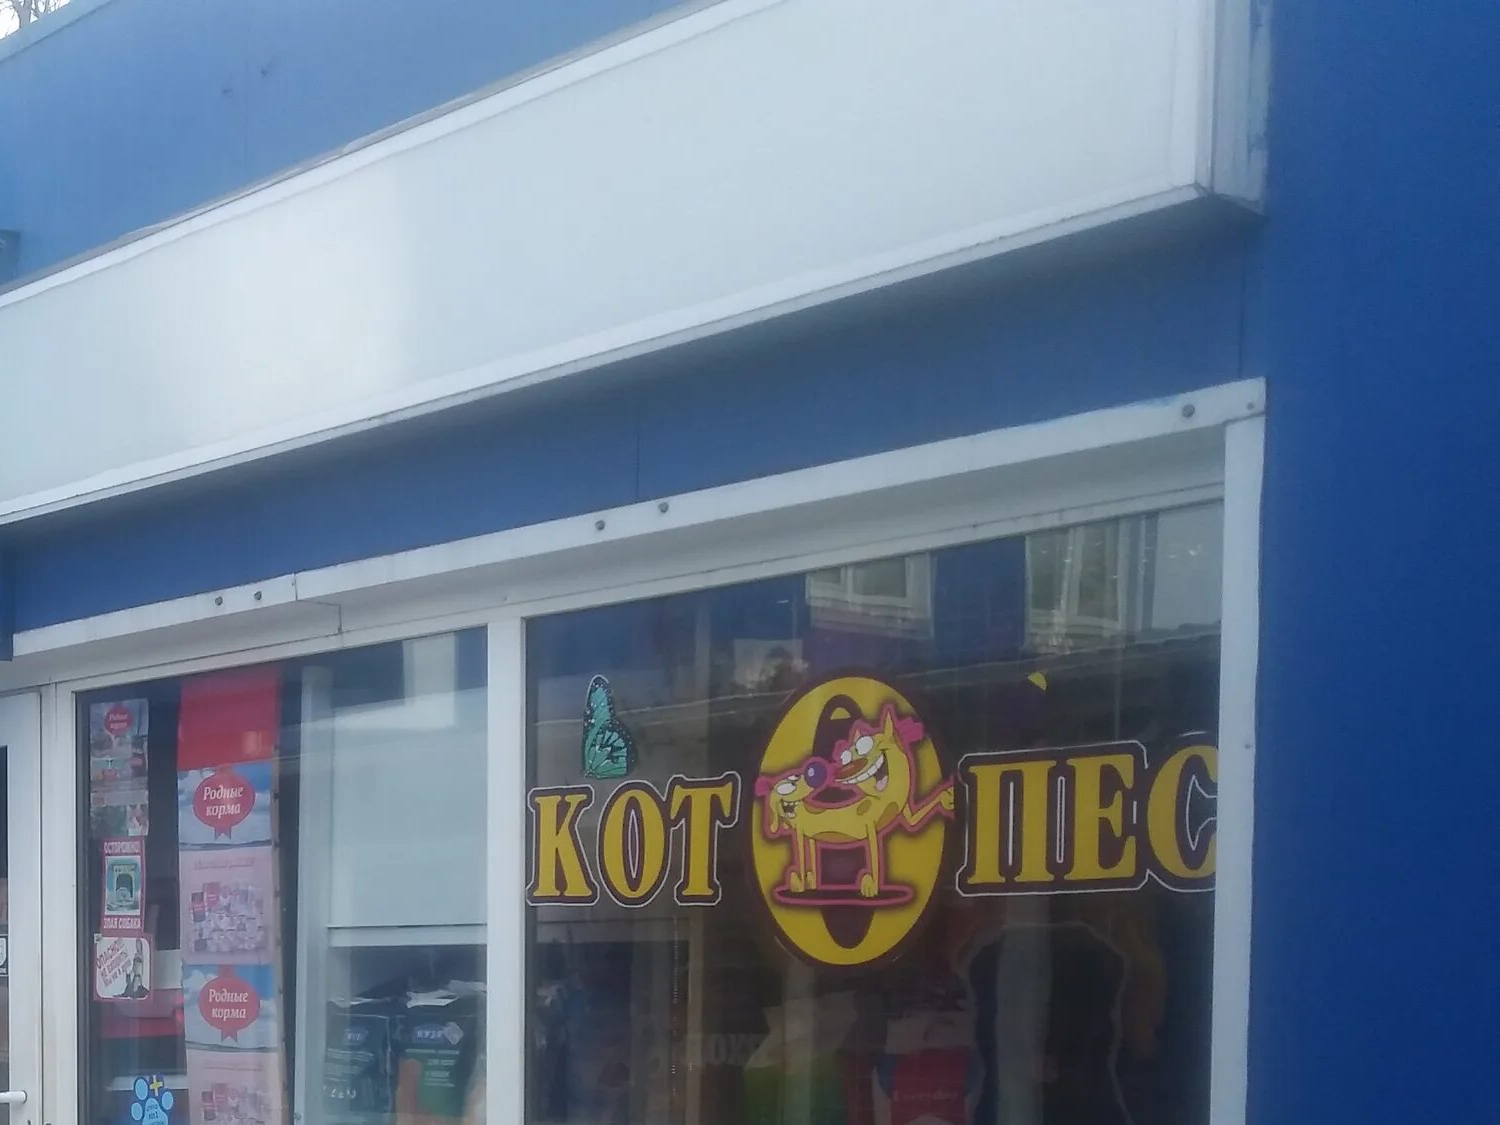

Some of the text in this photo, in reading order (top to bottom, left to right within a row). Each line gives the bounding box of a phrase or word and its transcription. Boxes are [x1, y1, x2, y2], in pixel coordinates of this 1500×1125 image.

[203, 784, 244, 801] Родные
[206, 803, 240, 819] корма
[209, 988, 249, 1003] Родные
[212, 1006, 246, 1022] корма
